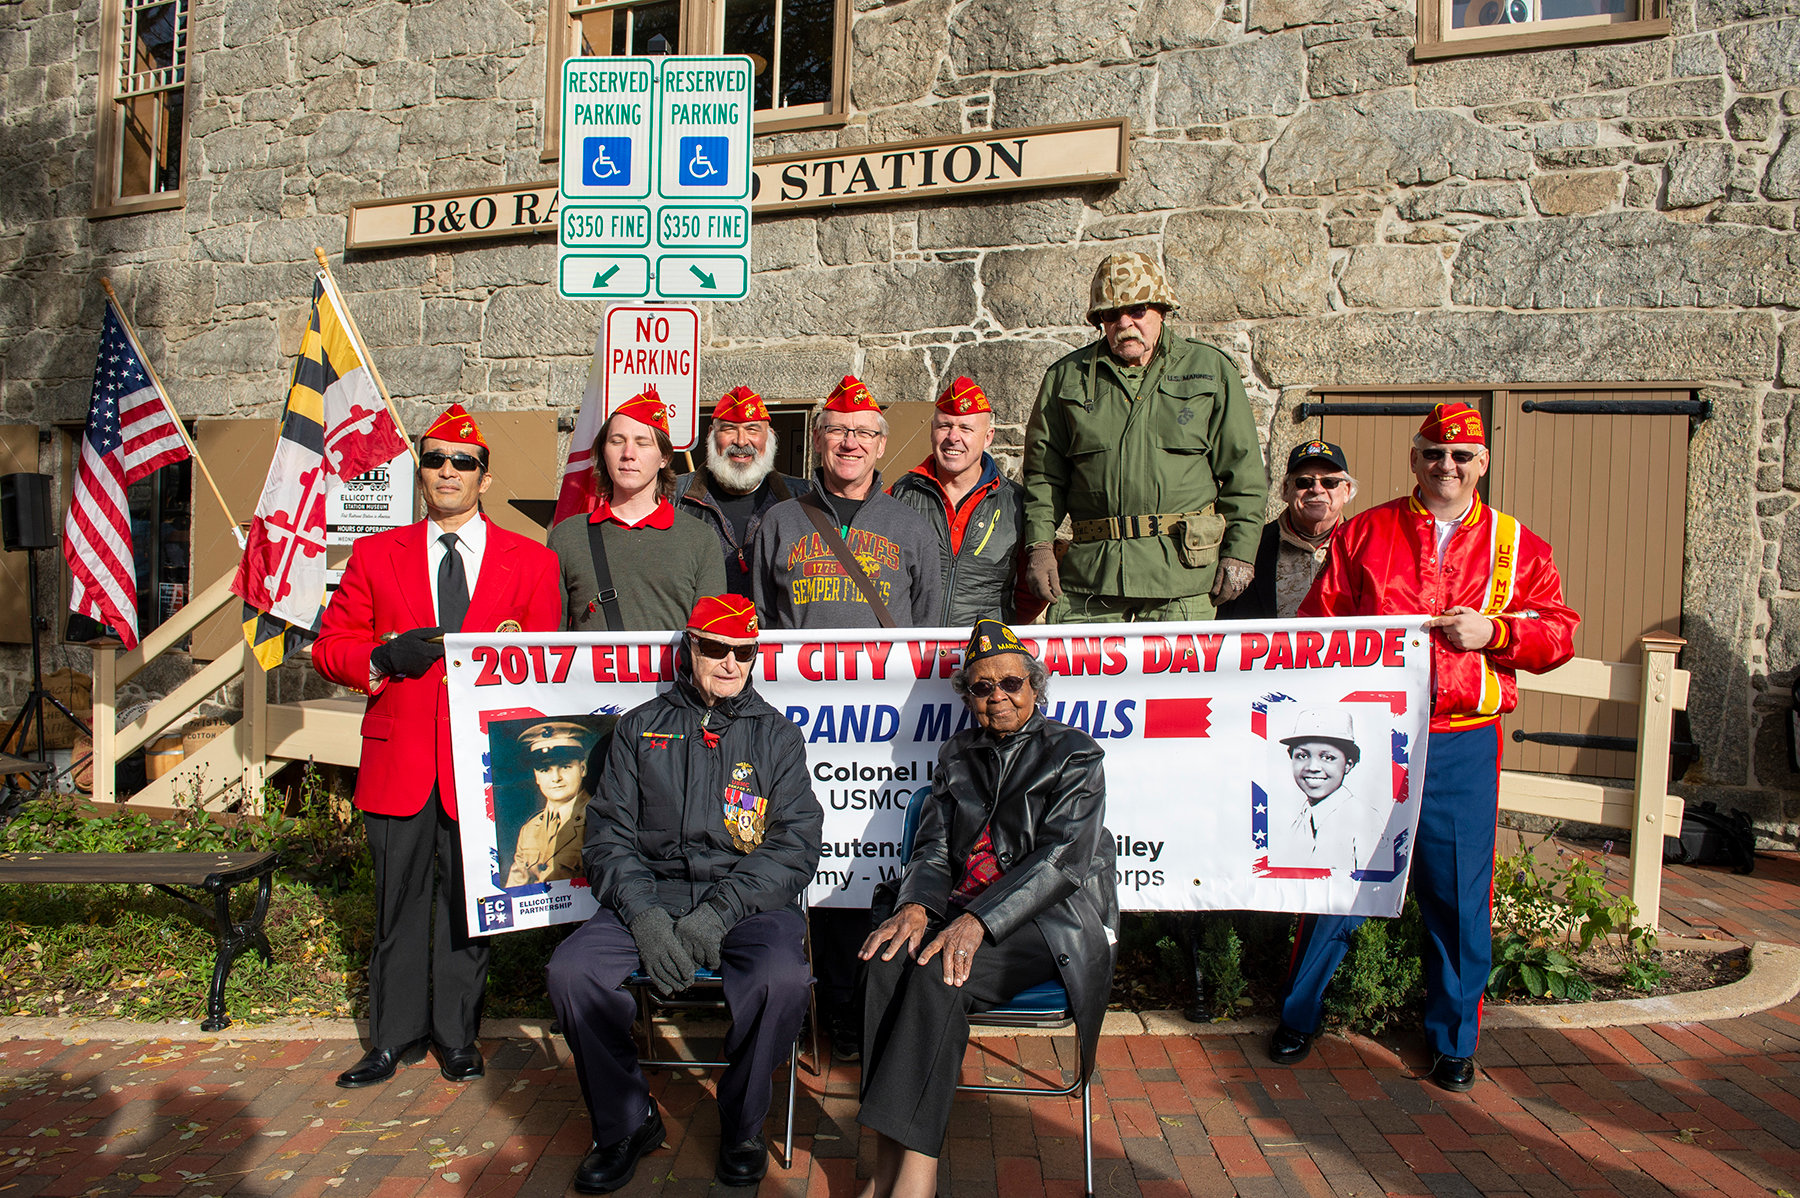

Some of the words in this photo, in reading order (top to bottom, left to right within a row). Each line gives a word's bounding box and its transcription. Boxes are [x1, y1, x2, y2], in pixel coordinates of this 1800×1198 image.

[568, 71, 649, 93] RESERVED
[665, 70, 746, 93] RESERVED
[574, 103, 642, 126] PARKING
[671, 102, 739, 125] PARKING
[780, 139, 1029, 202] STATION
[410, 196, 498, 236] B&O
[567, 213, 604, 240] $350
[611, 215, 645, 238] FINE
[663, 213, 700, 240] $350
[707, 215, 742, 238] FINE
[635, 317, 670, 343] NO
[613, 348, 691, 376] PARKING
[812, 563, 837, 575] 1775
[792, 577, 841, 605] SEMPER
[471, 644, 578, 687] 2017
[591, 643, 783, 683] ELLIT
[797, 640, 894, 681] CITY
[906, 634, 1128, 680] VEANS
[1142, 633, 1227, 675] DAY
[1239, 628, 1407, 671] PARADE
[784, 703, 900, 744] RAND
[813, 761, 918, 782] Colonel
[830, 788, 912, 811] USMC
[1116, 834, 1165, 862] iley
[519, 898, 554, 909] ELLICOTT
[554, 894, 572, 903] CITY
[519, 902, 573, 915] PARTNERSHIP
